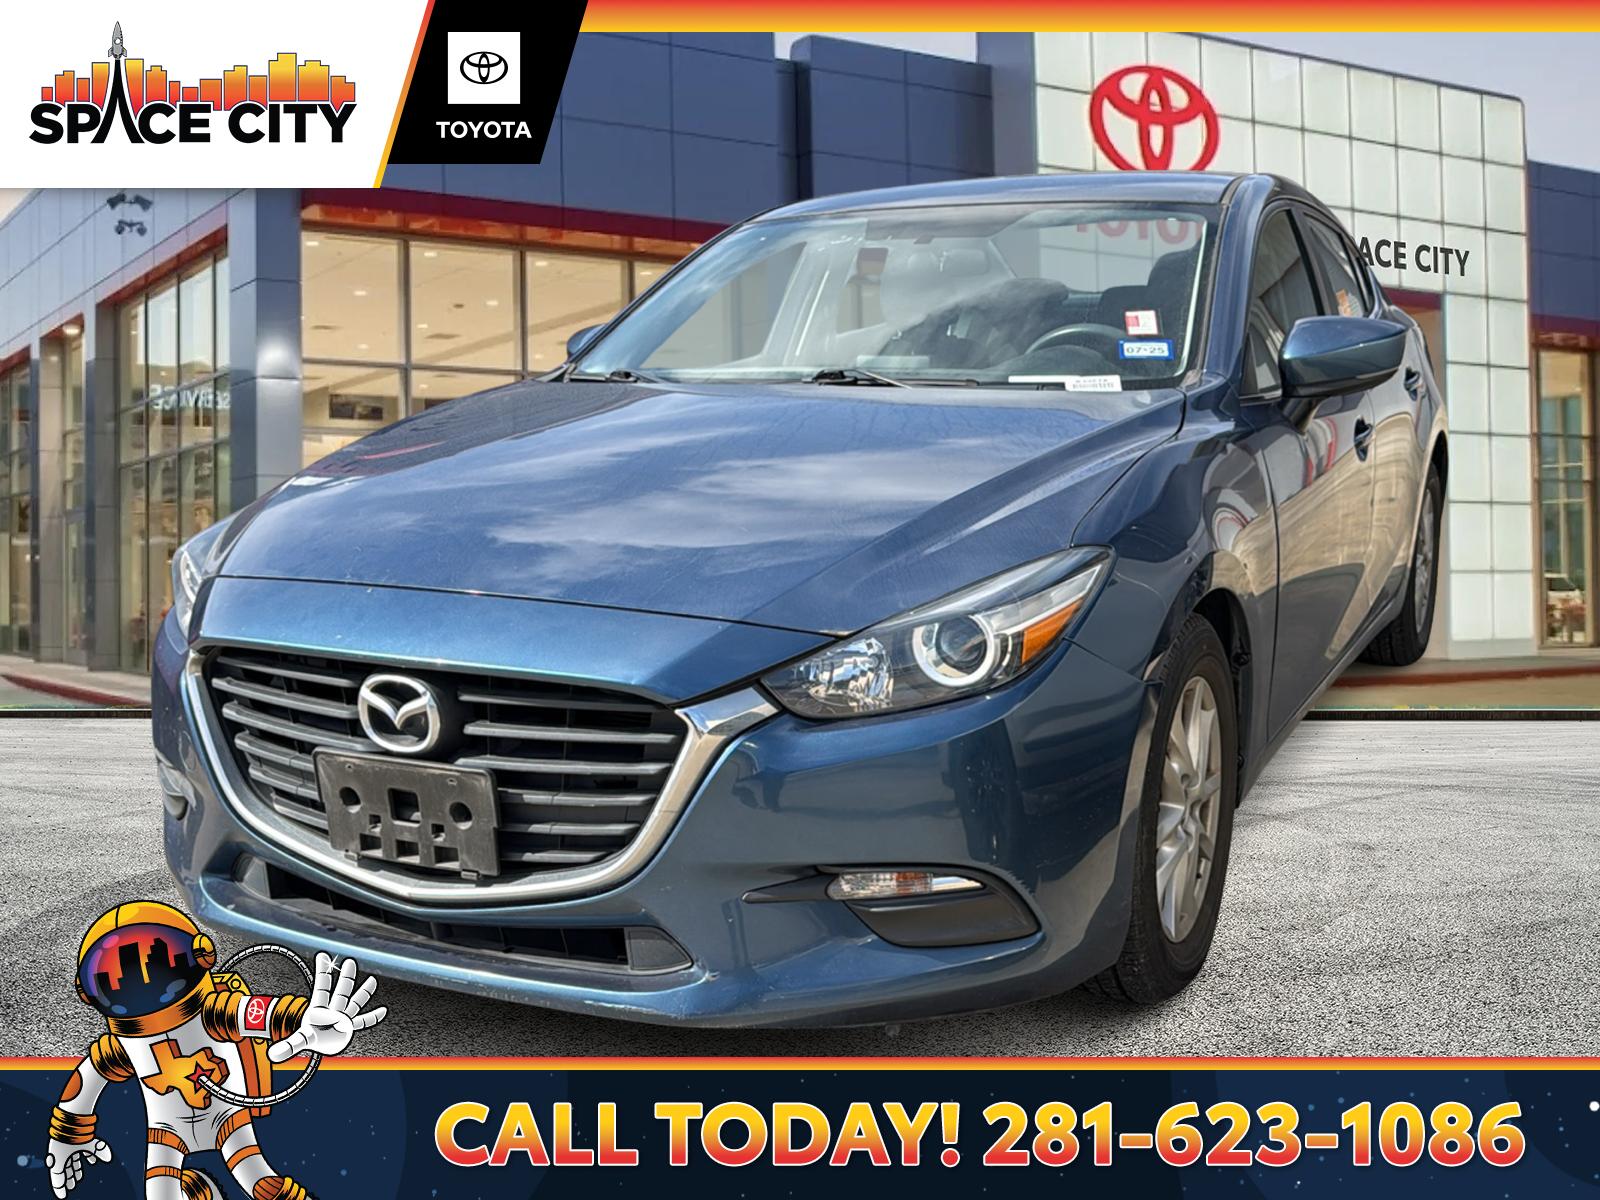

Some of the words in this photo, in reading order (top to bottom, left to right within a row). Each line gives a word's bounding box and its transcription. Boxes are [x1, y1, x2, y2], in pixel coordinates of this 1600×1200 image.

[1359, 236, 1407, 270] ACE
[1414, 244, 1470, 277] CITY
[1125, 345, 1166, 355] 07-25
